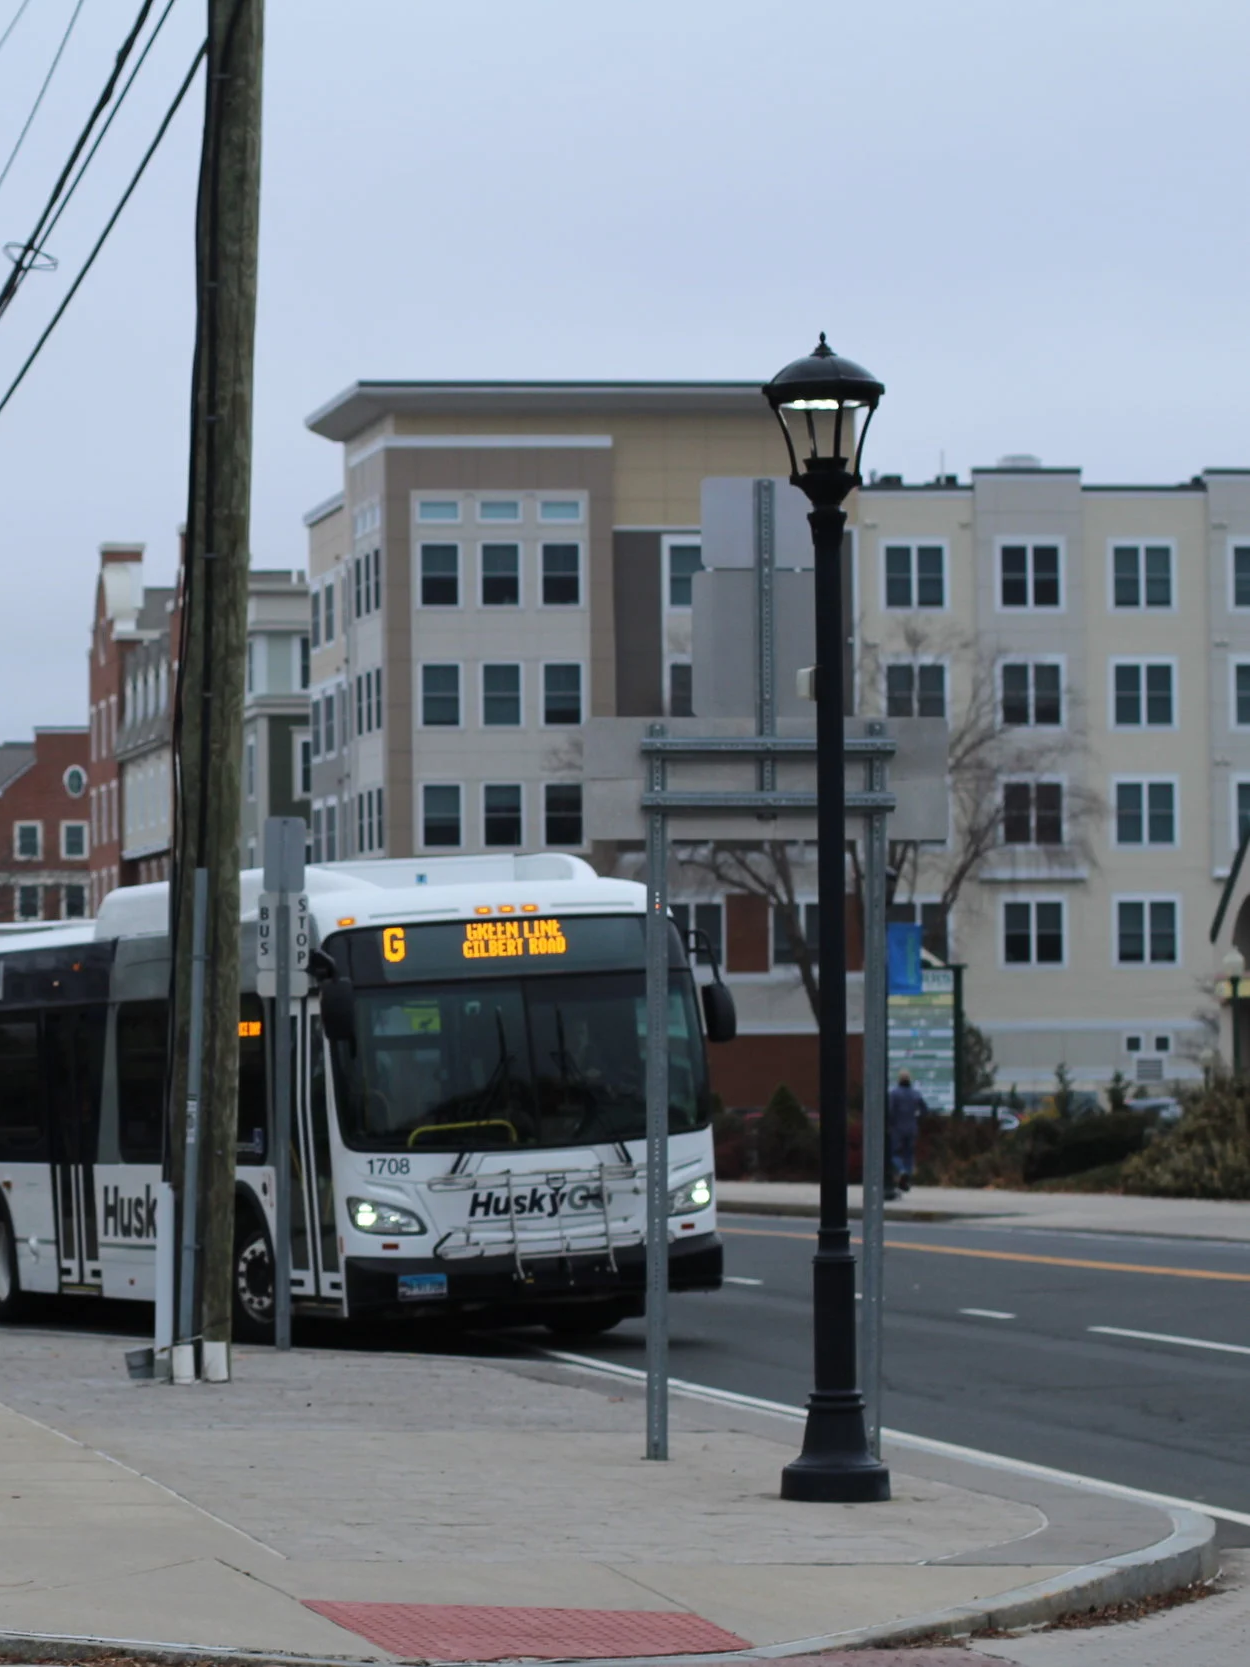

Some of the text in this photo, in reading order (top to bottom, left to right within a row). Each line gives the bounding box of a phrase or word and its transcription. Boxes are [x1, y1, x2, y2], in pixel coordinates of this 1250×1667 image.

[259, 898, 307, 964] BUS STOP
[465, 919, 562, 941] GREEN LINE
[383, 927, 406, 962] G
[462, 935, 567, 958] GILBERT ROAD
[366, 1157, 410, 1175] 1708
